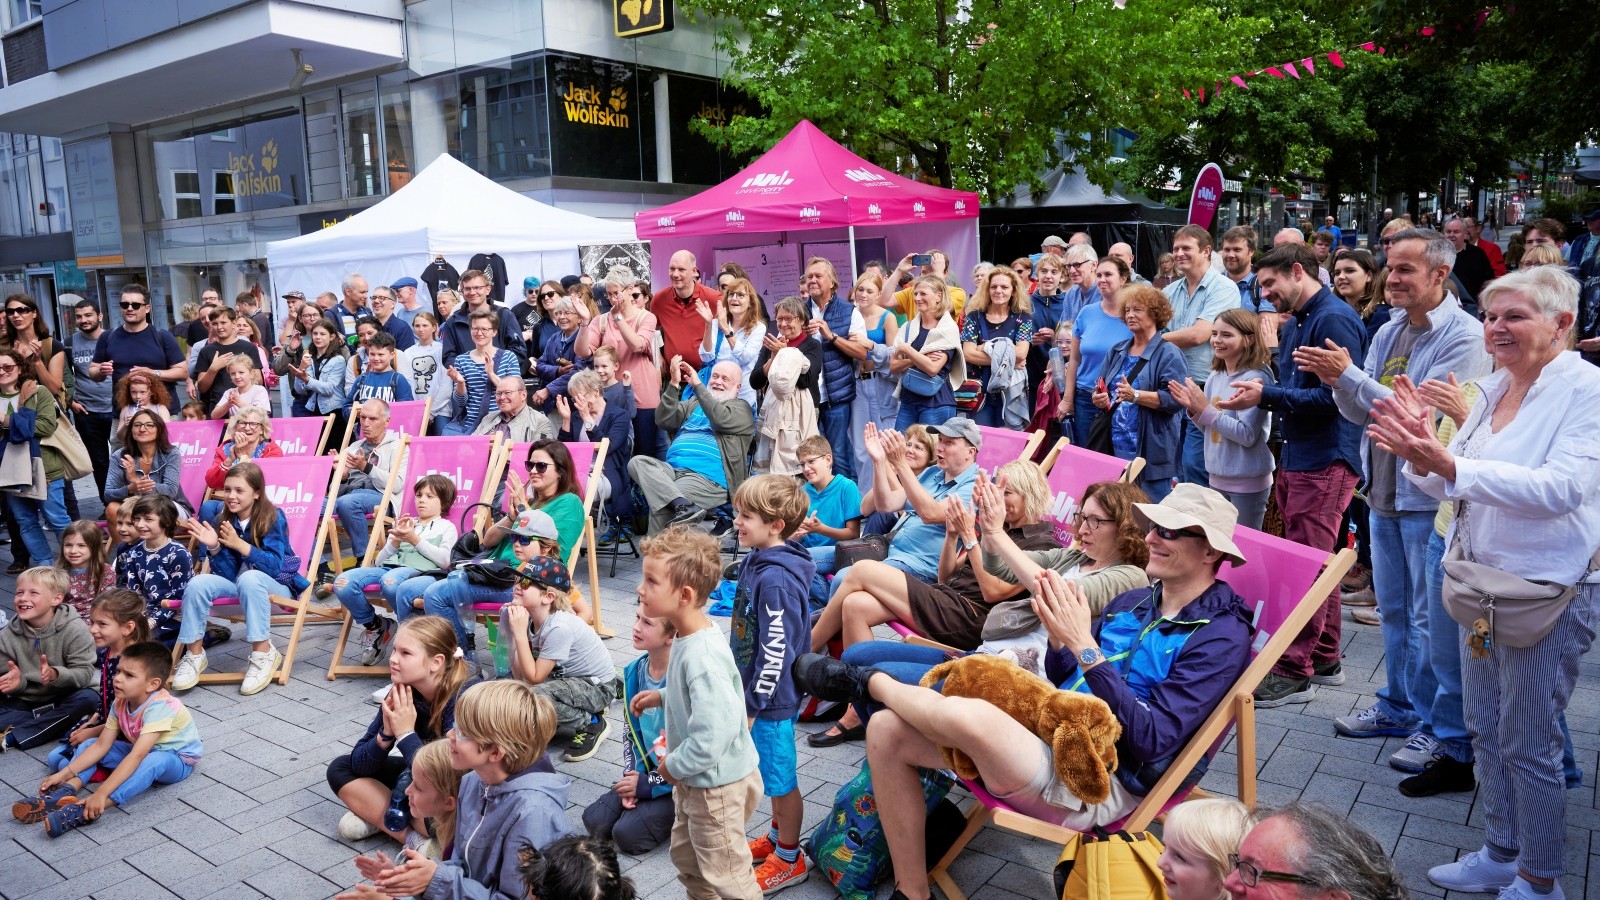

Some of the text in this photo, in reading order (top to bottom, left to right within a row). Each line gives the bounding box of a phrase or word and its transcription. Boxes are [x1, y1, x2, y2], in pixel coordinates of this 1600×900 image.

[564, 82, 601, 105] Jack
[564, 101, 630, 129] Wolfskin
[698, 101, 726, 121] Jack
[226, 151, 256, 175] Jack
[226, 171, 281, 198] Wolfskin
[753, 602, 787, 699] NINJAGO
[764, 863, 798, 889] Escape
